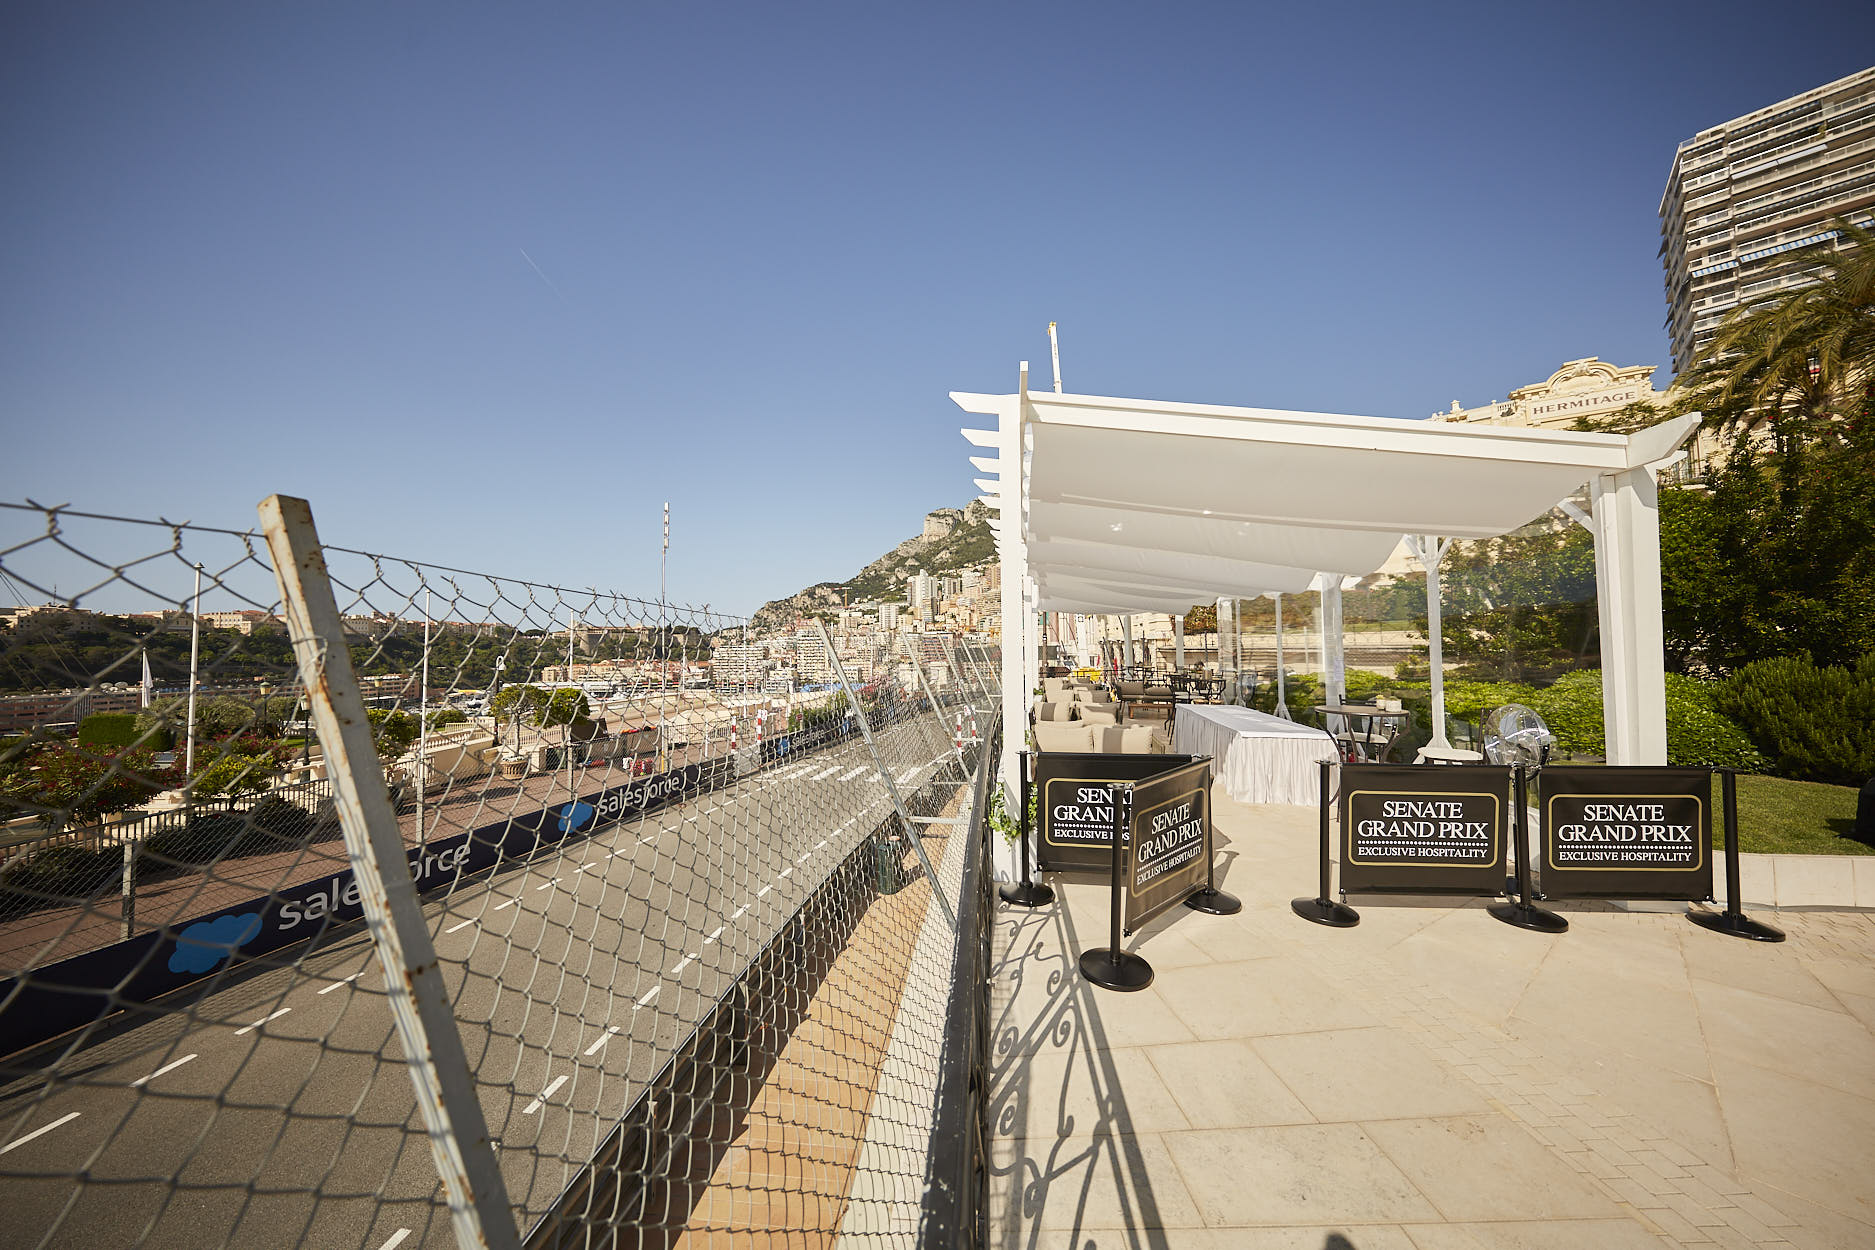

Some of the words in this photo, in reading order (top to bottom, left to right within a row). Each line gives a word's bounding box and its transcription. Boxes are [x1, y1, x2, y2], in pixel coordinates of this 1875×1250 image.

[1533, 391, 1636, 415] HERMITAGE
[599, 776, 680, 815] salesforce
[1151, 802, 1190, 835] SENATE
[1382, 800, 1463, 819] SENATE
[1583, 804, 1665, 822] SENATE
[1054, 829, 1109, 840] EXCLUSIVE
[1357, 820, 1435, 838] GRAND
[1438, 822, 1489, 840] PRIX
[1558, 824, 1637, 842] GRAND
[1640, 825, 1693, 843] PRIX
[1138, 829, 1178, 863] GRAND
[1178, 818, 1202, 844] PRIX
[1358, 847, 1416, 857] EXCLUSIVE
[1417, 848, 1488, 858] HOSPITALITY
[1559, 851, 1619, 861] EXCLUSIVE
[1620, 852, 1692, 862] HOSPITALITY
[1136, 861, 1169, 886] EXCLUSIVE
[1168, 844, 1202, 871] HOSPITALITY
